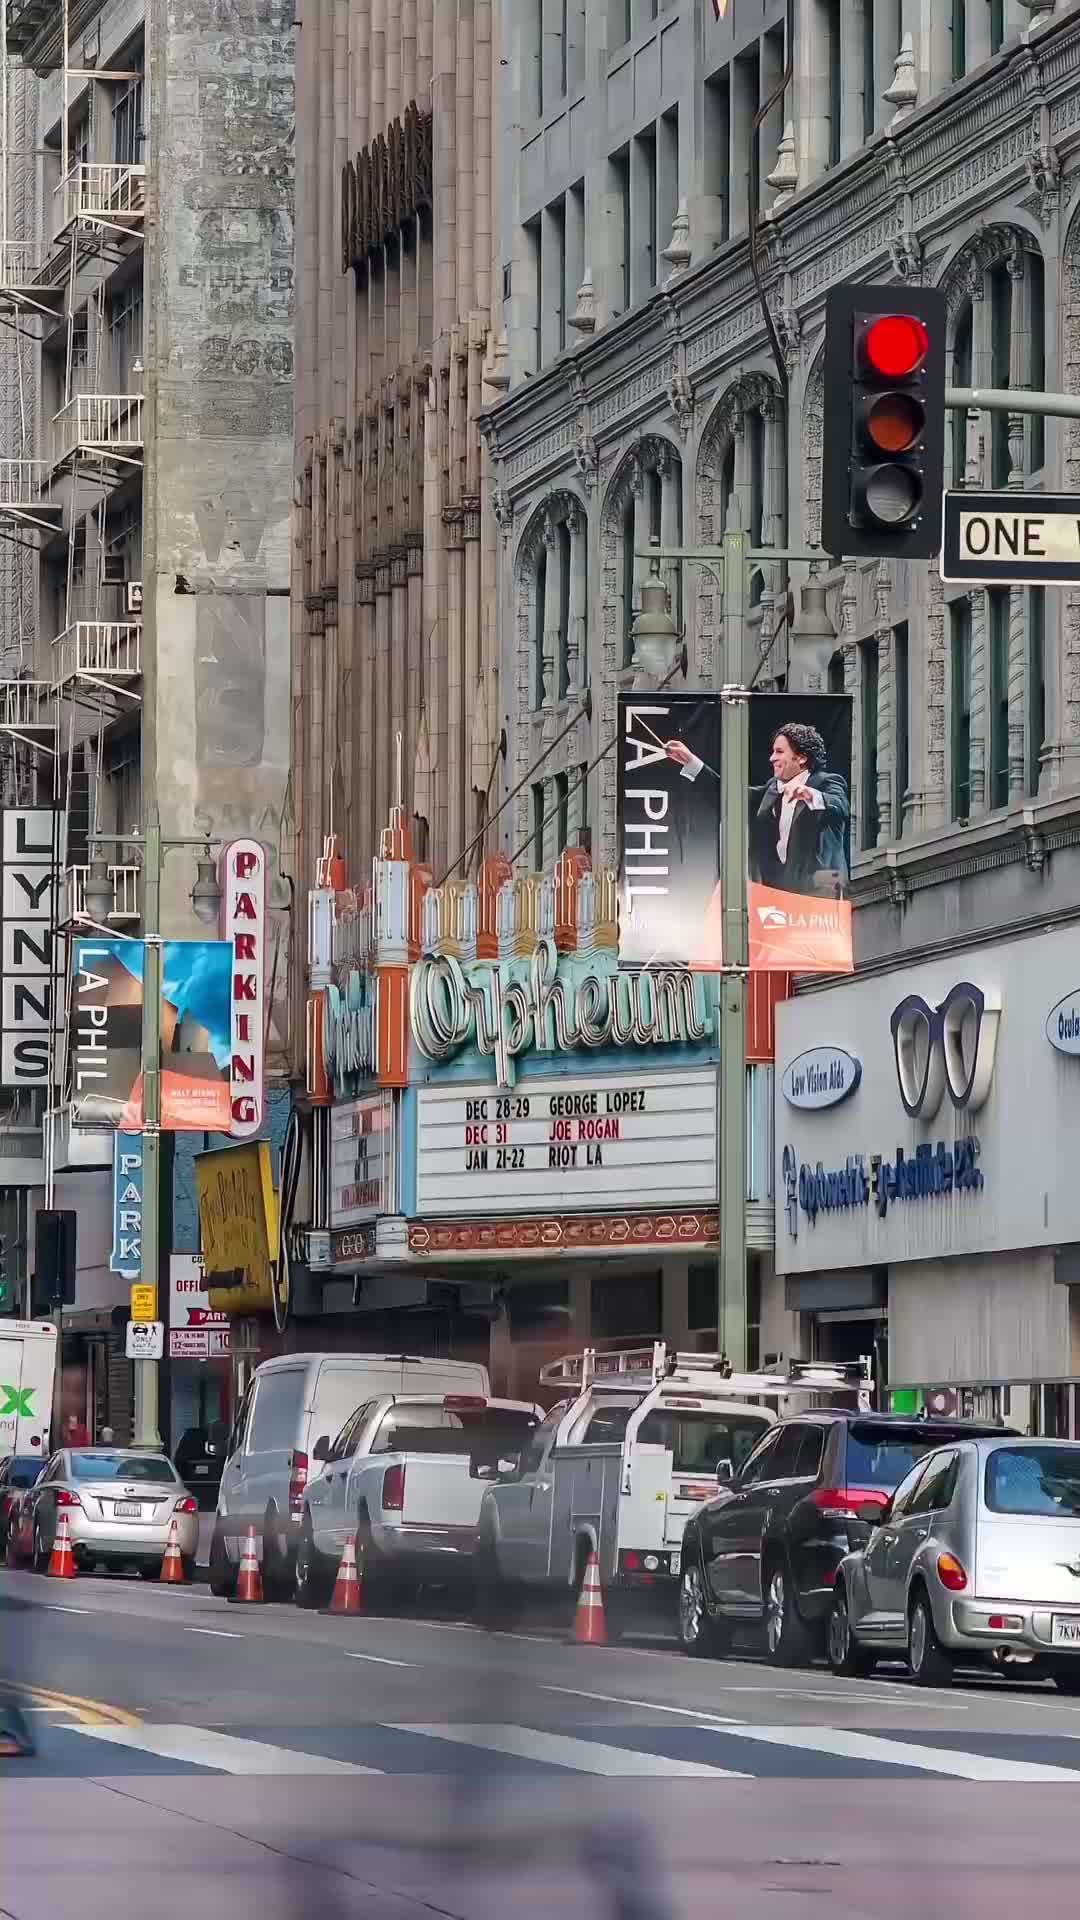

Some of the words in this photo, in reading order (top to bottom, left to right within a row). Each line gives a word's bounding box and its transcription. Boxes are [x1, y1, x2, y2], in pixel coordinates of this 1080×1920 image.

[966, 518, 1046, 556] ONE
[625, 706, 670, 772] LA
[625, 789, 669, 913] PHIL
[788, 912, 807, 928] LA
[13, 818, 54, 1079] LYNNS
[78, 949, 109, 993] LA
[231, 852, 258, 1123] PARKING
[411, 939, 713, 1088] Orpheum
[1058, 1008, 1080, 1040] Ocula
[76, 1004, 108, 1090] PHIL
[791, 1069, 805, 1096] Low
[807, 1064, 828, 1095] Vision
[829, 1059, 844, 1090] Aids
[466, 1100, 488, 1120] DEC
[496, 1098, 530, 1118] 28-29
[550, 1094, 597, 1115] GEORGE
[606, 1091, 645, 1112] LOPEZ
[465, 1125, 488, 1145] DEC
[496, 1123, 507, 1143] 31
[549, 1121, 571, 1140] JOE
[578, 1119, 620, 1139] ROGAN
[466, 1150, 488, 1170] JAN
[496, 1148, 525, 1168] 21-22
[549, 1145, 577, 1167] RIOT
[586, 1144, 603, 1165] LA
[119, 1154, 142, 1259] PARK
[176, 1280, 199, 1292] OFFI
